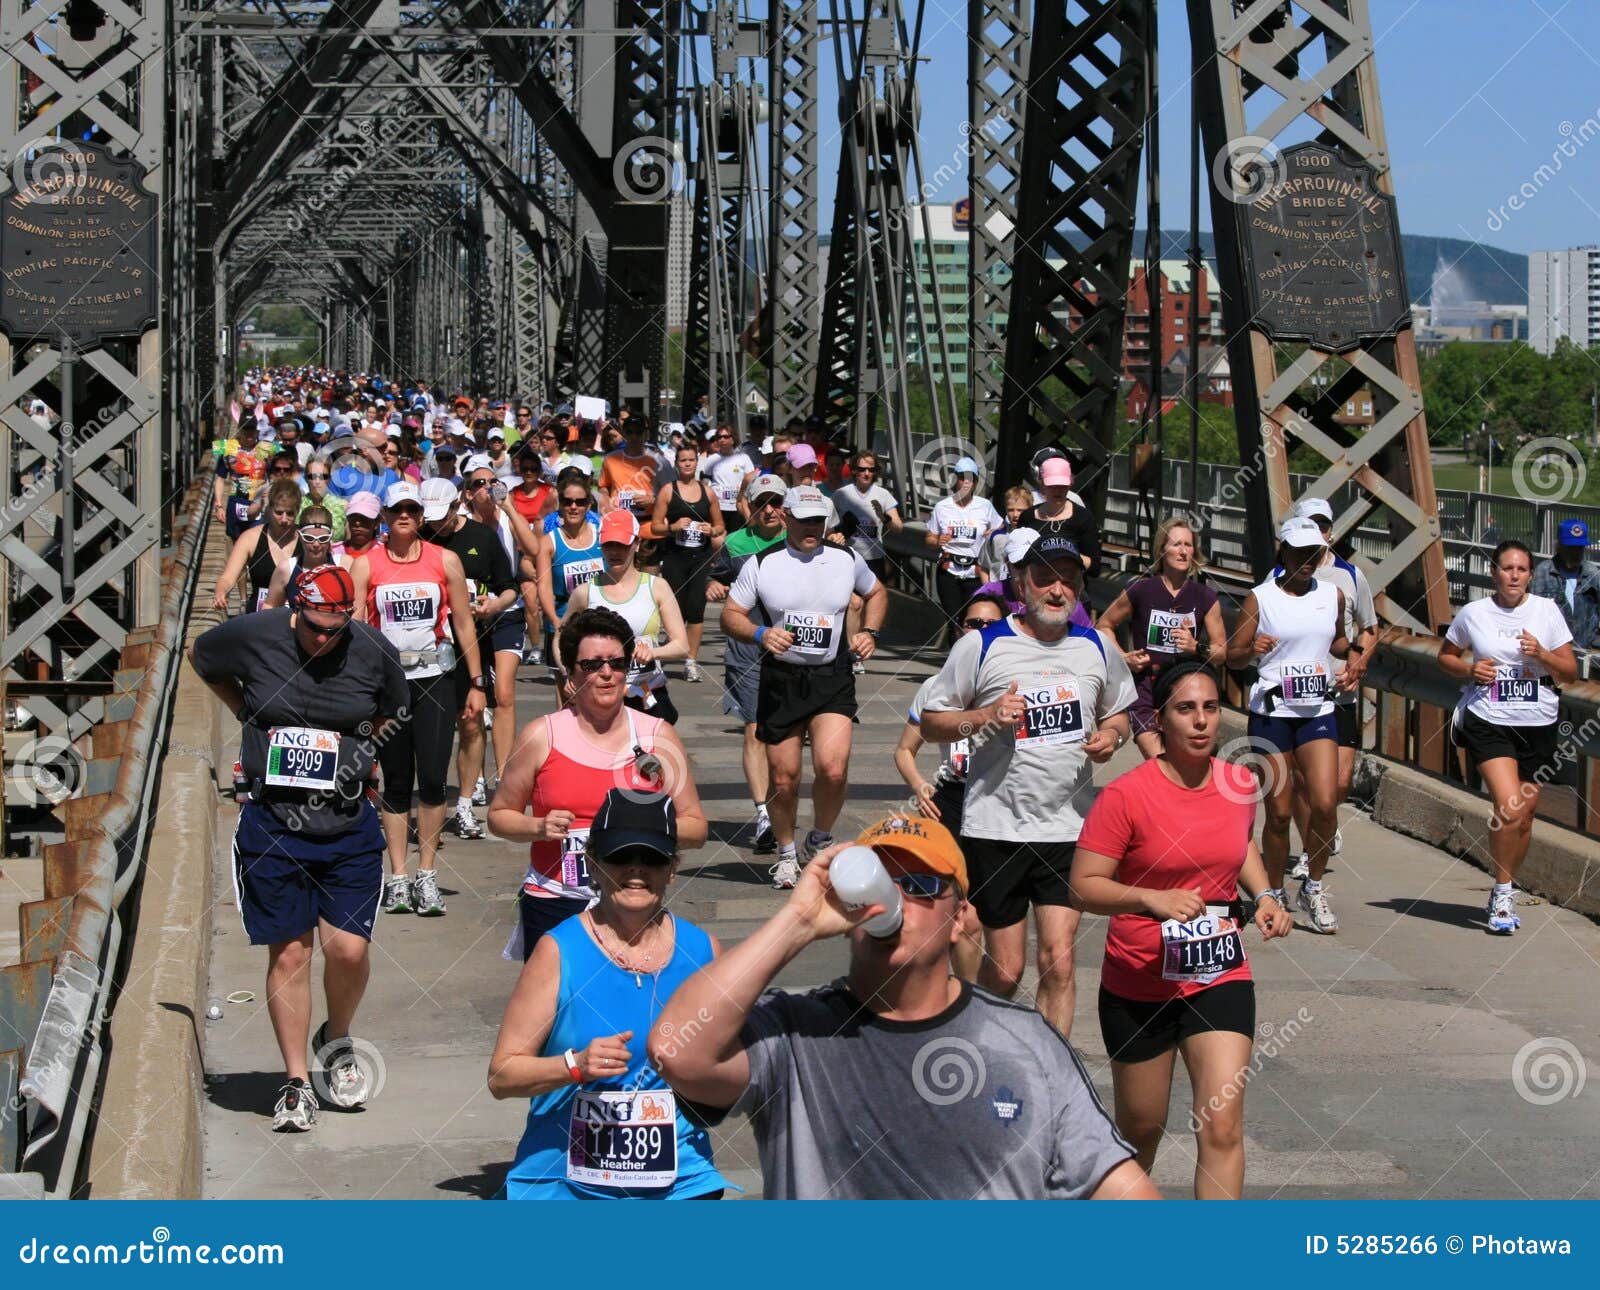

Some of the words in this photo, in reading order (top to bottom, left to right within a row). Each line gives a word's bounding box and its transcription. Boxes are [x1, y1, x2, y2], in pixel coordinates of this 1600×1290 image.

[61, 152, 96, 164] 1900
[1295, 156, 1330, 167] 1900
[10, 173, 144, 211] INTERPROVINCIAL
[51, 195, 105, 205] BRIDGE
[1253, 176, 1384, 215] INTERPROVINCIAL
[1292, 197, 1346, 208] BRIDGE
[7, 215, 64, 239] DOMINION
[68, 227, 114, 240] BRIDGE
[1252, 217, 1310, 241] DOMINION
[1314, 228, 1359, 241] BRIDGE
[6, 258, 57, 280] PONTIAC
[63, 257, 115, 270] PACIFIC
[1258, 259, 1308, 281] PONTIAC
[1312, 258, 1363, 272] PACIFIC
[6, 288, 57, 305] OTTAWA
[68, 291, 131, 306] GATINEAU
[1262, 289, 1312, 306] OTTAWA
[1323, 293, 1384, 306] GATINEAU
[566, 564, 588, 574] ING
[385, 589, 412, 600] ING
[395, 600, 427, 616] 11847
[787, 614, 814, 626] ING
[1153, 615, 1179, 627] ING
[797, 627, 824, 643] 9030
[1285, 664, 1313, 676] ING
[1498, 668, 1519, 679] NG
[1294, 676, 1323, 693] 11601
[1500, 681, 1533, 697] 11600
[1023, 690, 1051, 706] NG
[1027, 703, 1074, 731] 12673
[273, 731, 310, 748] ING
[1039, 727, 1062, 736] James
[287, 748, 324, 772] 9909
[295, 769, 310, 778] Eric
[1166, 919, 1214, 942] ING
[1184, 934, 1236, 967] 11148
[575, 1098, 634, 1122] ING
[590, 1126, 661, 1160] 11389
[600, 1158, 647, 1170] Heather
